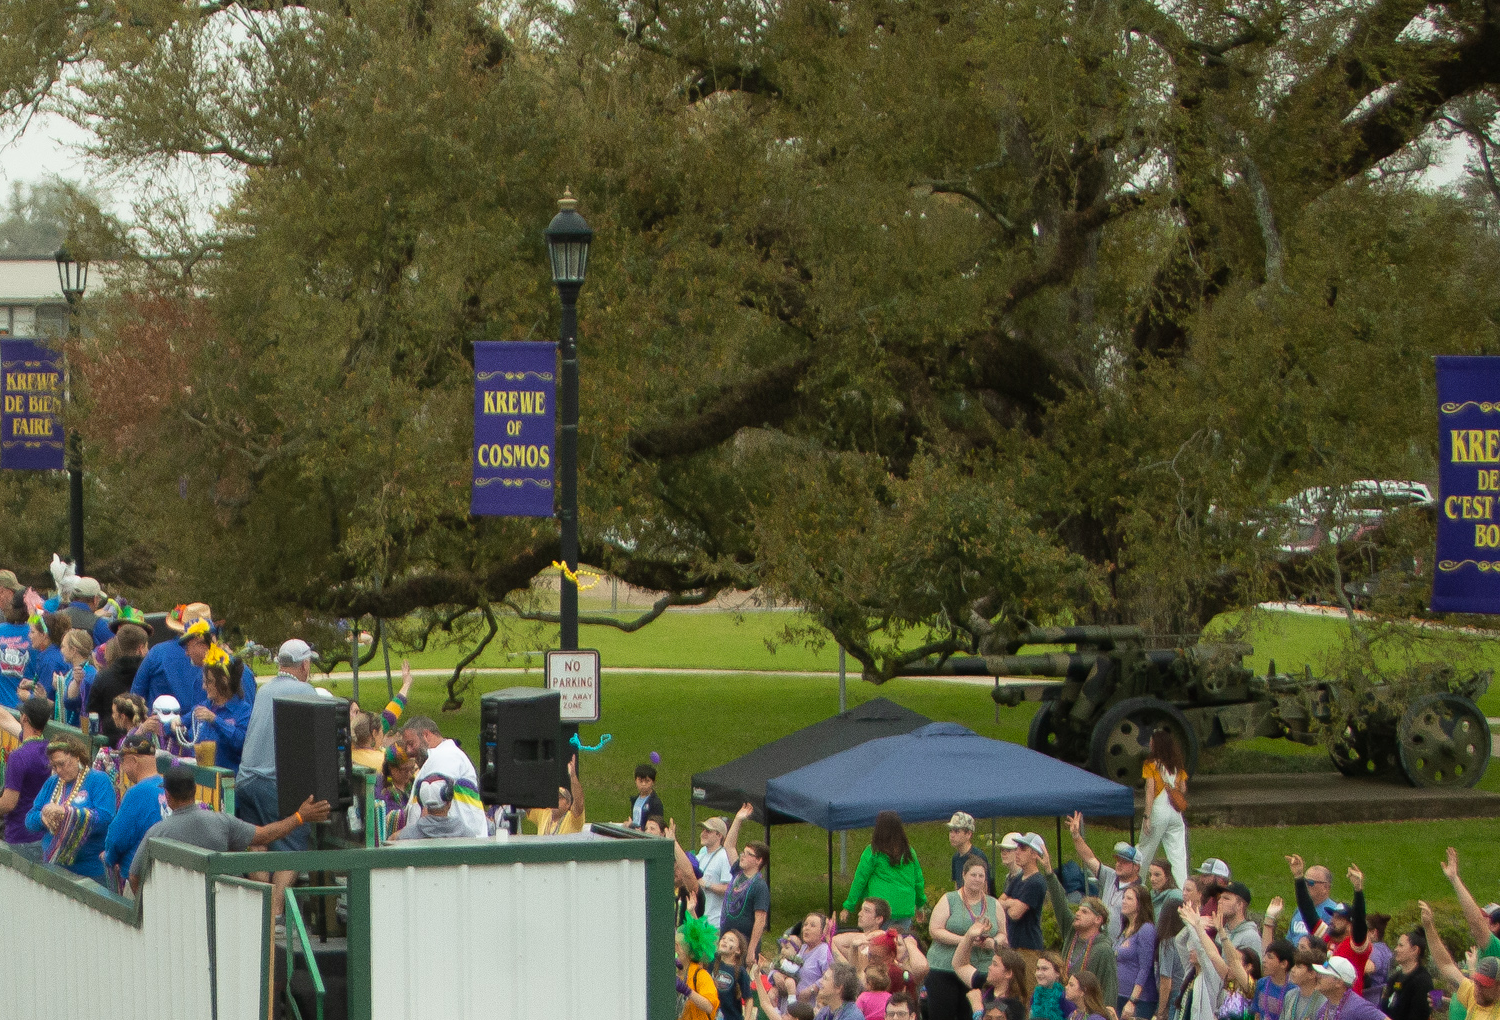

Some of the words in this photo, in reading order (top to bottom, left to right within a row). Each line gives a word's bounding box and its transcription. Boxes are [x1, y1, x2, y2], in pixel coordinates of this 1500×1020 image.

[6, 373, 59, 391] KREWE
[4, 395, 25, 413] DE
[484, 391, 546, 414] KREWE
[12, 418, 53, 436] FAIRE
[506, 420, 522, 436] OF
[1450, 430, 1500, 463] KRE
[478, 444, 550, 468] COSMOS
[1444, 495, 1494, 519] C'EST
[1474, 524, 1500, 548] BO
[564, 660, 581, 671] NO
[552, 677, 593, 688] PARKING
[563, 701, 582, 709] ZONE
